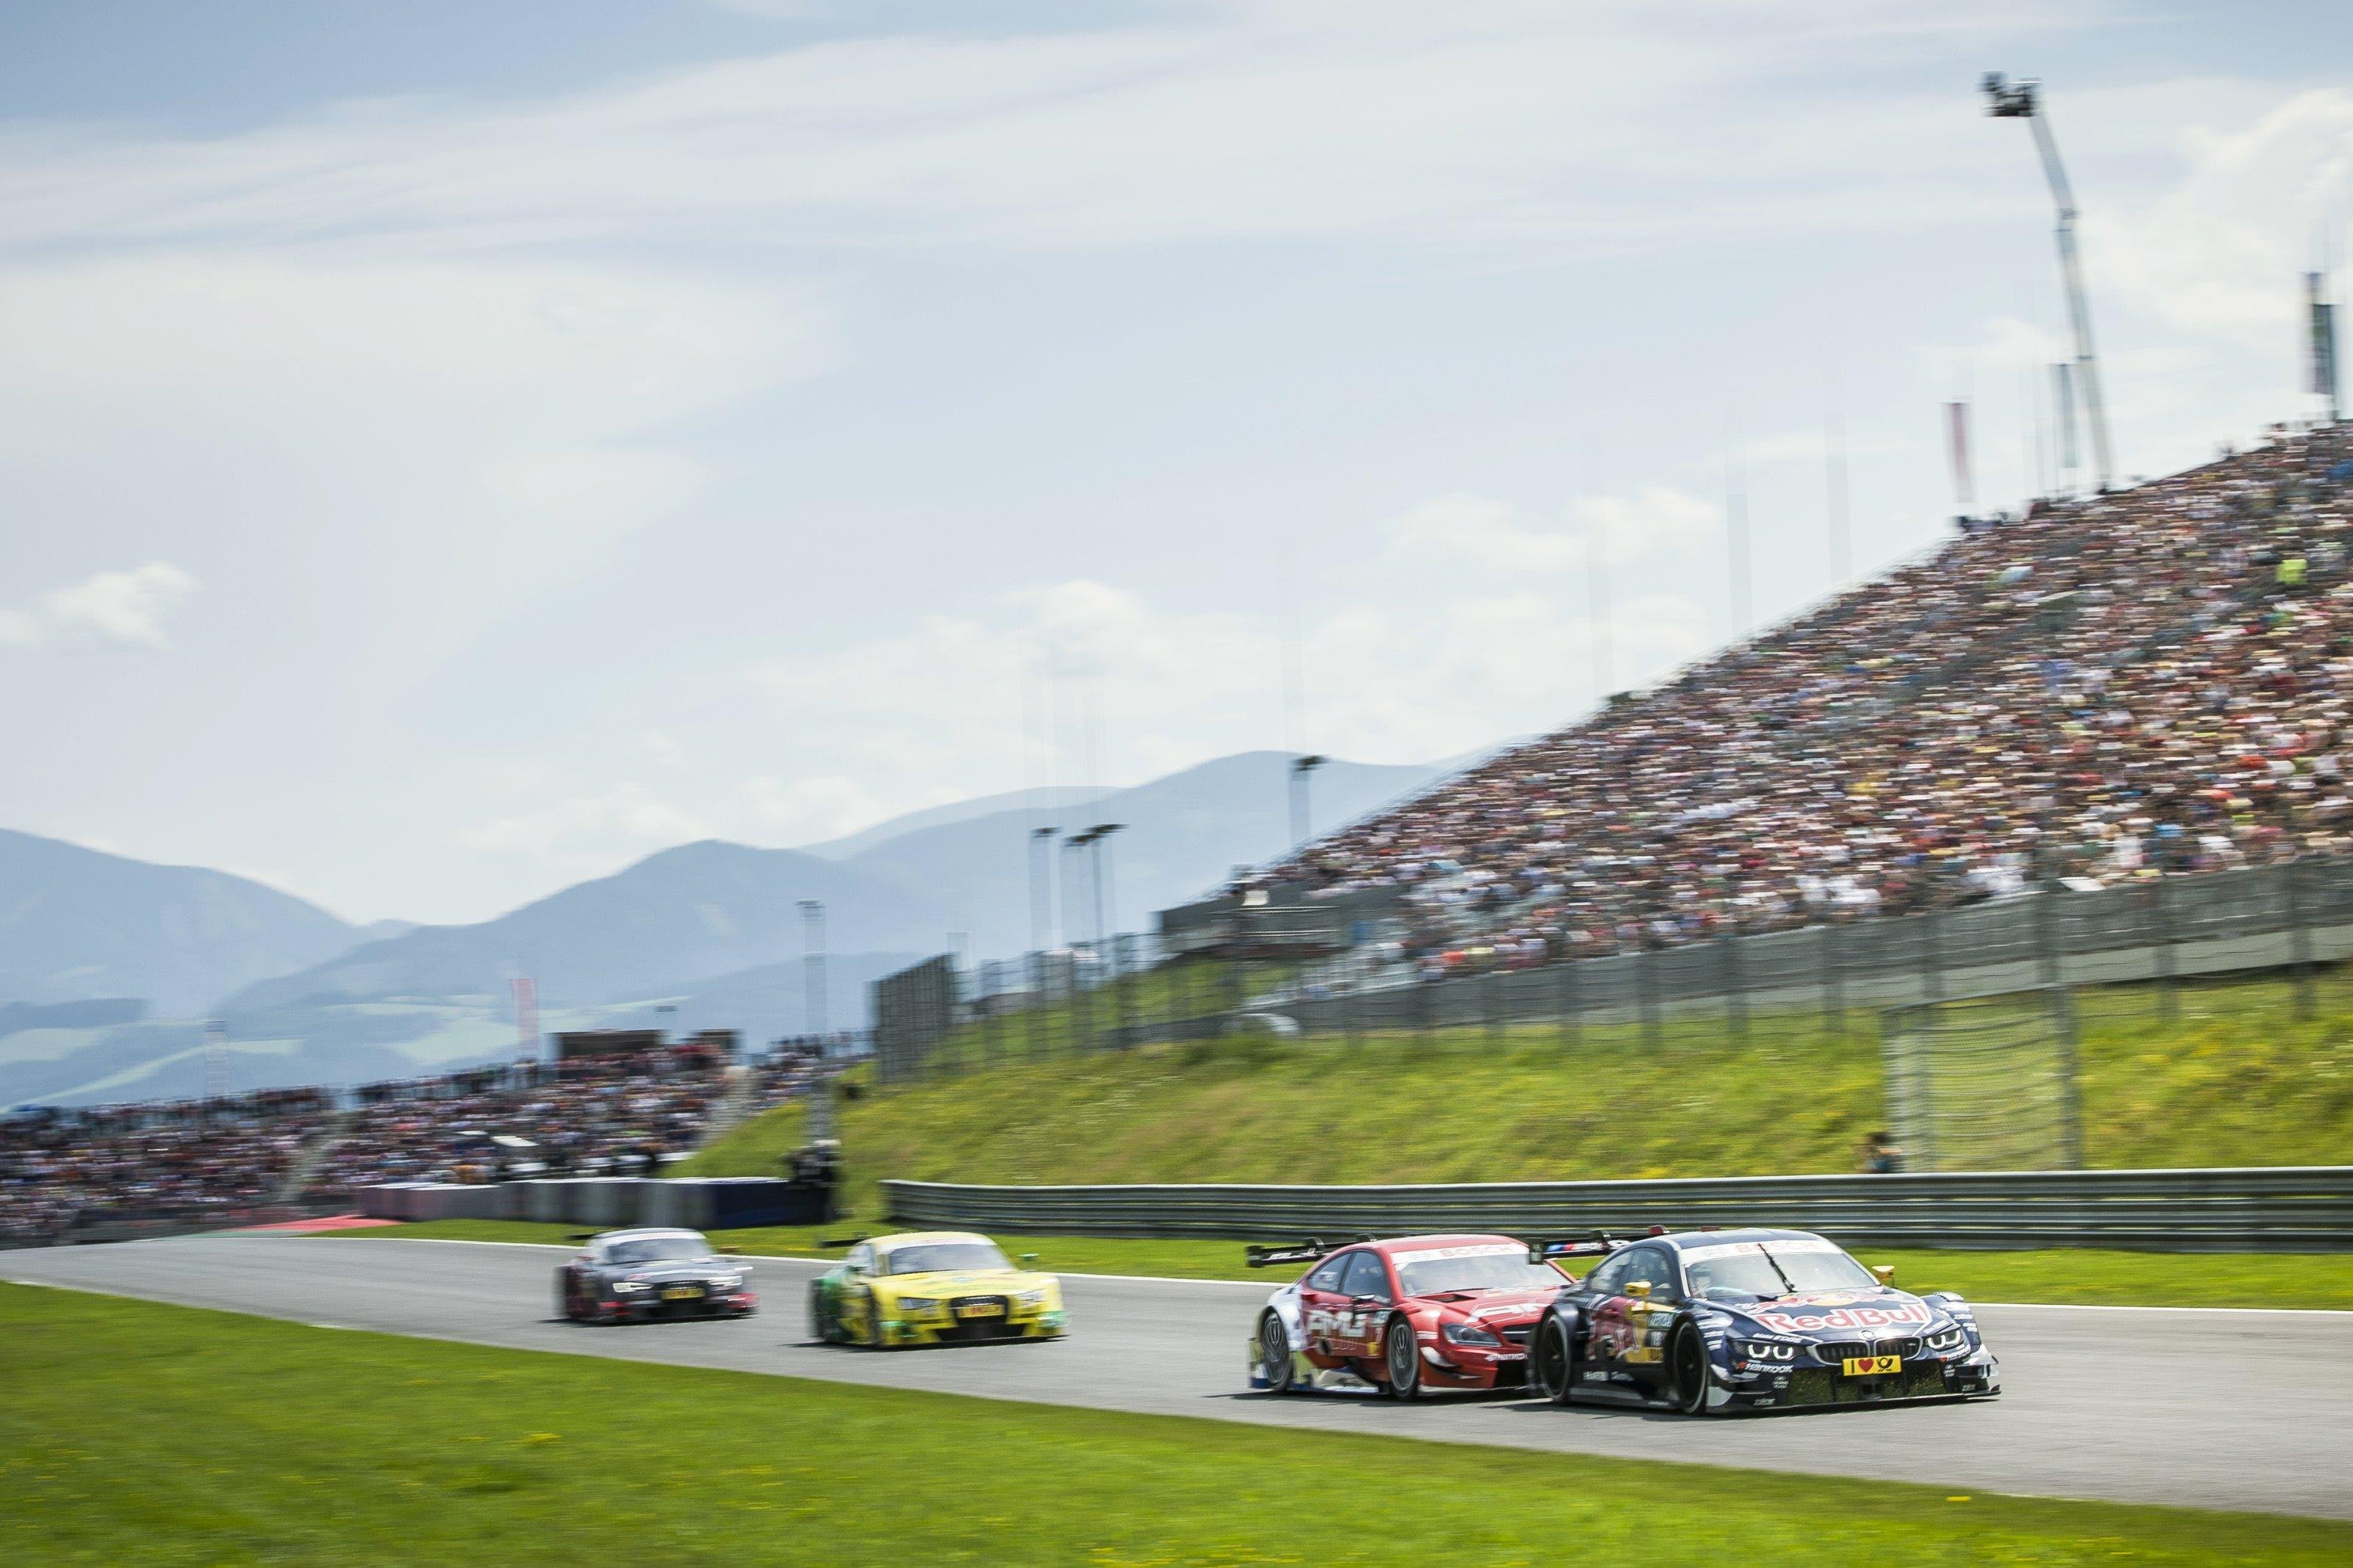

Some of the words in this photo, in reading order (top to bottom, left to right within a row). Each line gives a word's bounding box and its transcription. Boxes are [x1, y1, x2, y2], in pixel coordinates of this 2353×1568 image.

[1440, 1244, 1515, 1257] BOSCH
[1756, 1309, 1850, 1331] Red
[1852, 1305, 1929, 1326] Bull
